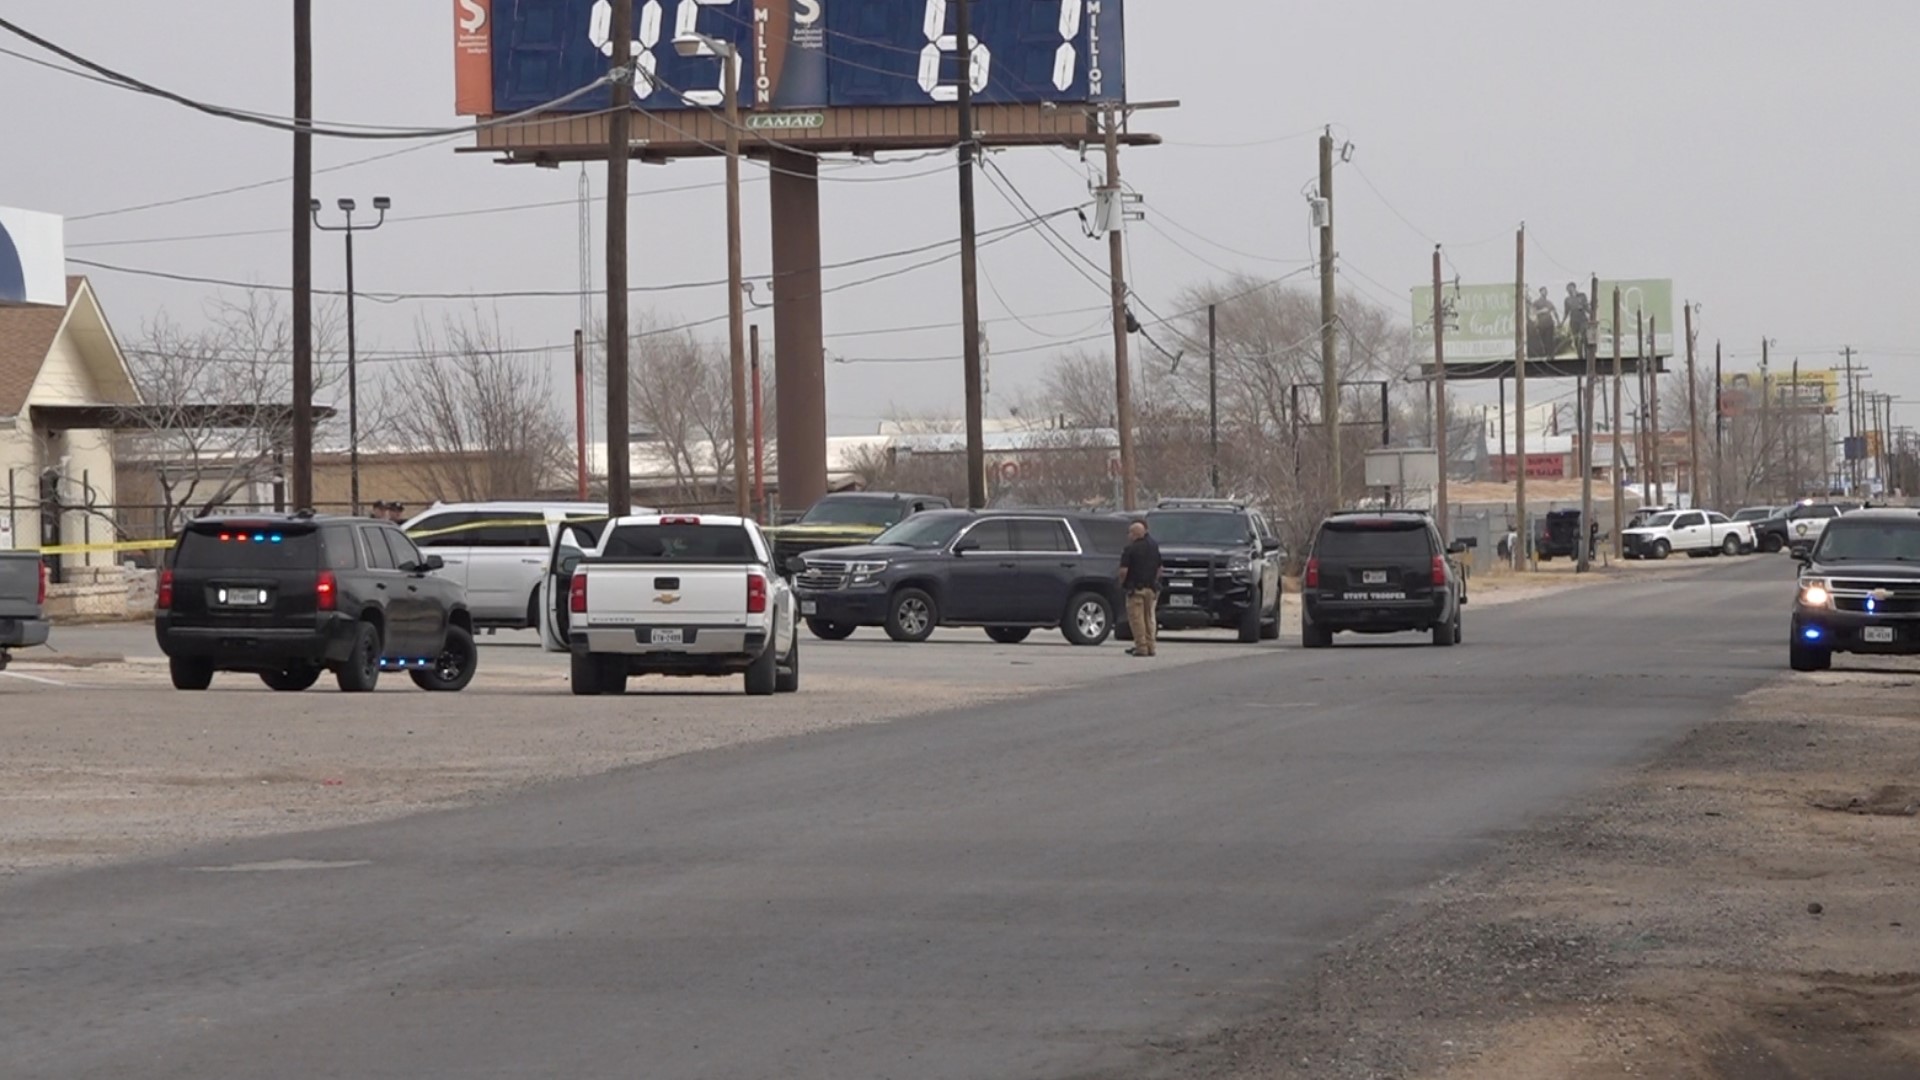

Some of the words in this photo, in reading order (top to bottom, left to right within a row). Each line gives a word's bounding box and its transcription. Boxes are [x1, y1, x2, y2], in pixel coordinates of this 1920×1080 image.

[754, 8, 770, 103] MILLION
[1087, 1, 1102, 95] MILLION
[752, 115, 816, 128] LAMAR
[1343, 592, 1368, 600] STATE
[1370, 592, 1406, 600] TROOPER
